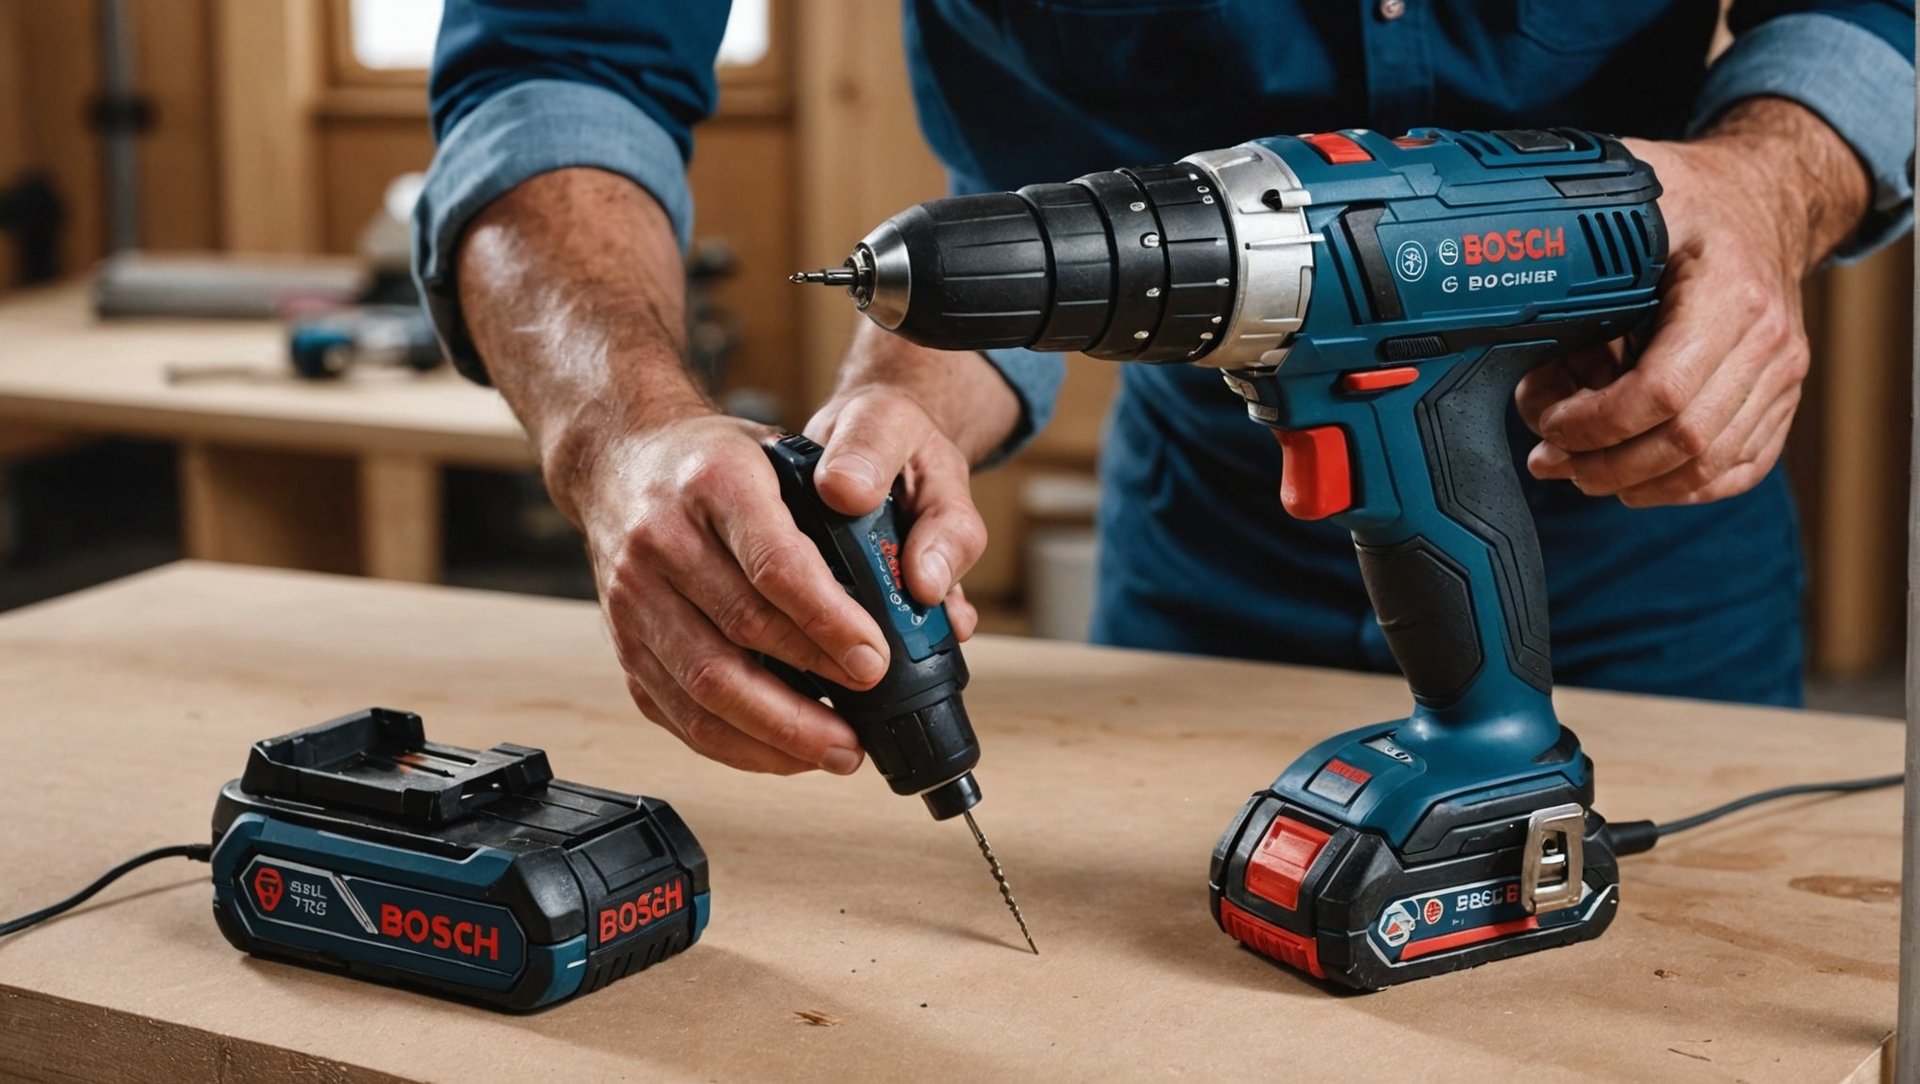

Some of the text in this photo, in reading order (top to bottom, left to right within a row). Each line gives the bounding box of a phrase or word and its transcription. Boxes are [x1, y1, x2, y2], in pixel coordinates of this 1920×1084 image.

[1463, 226, 1565, 265] BOSCH
[380, 904, 499, 960] BOSCH
[600, 879, 683, 944] BOSCH
